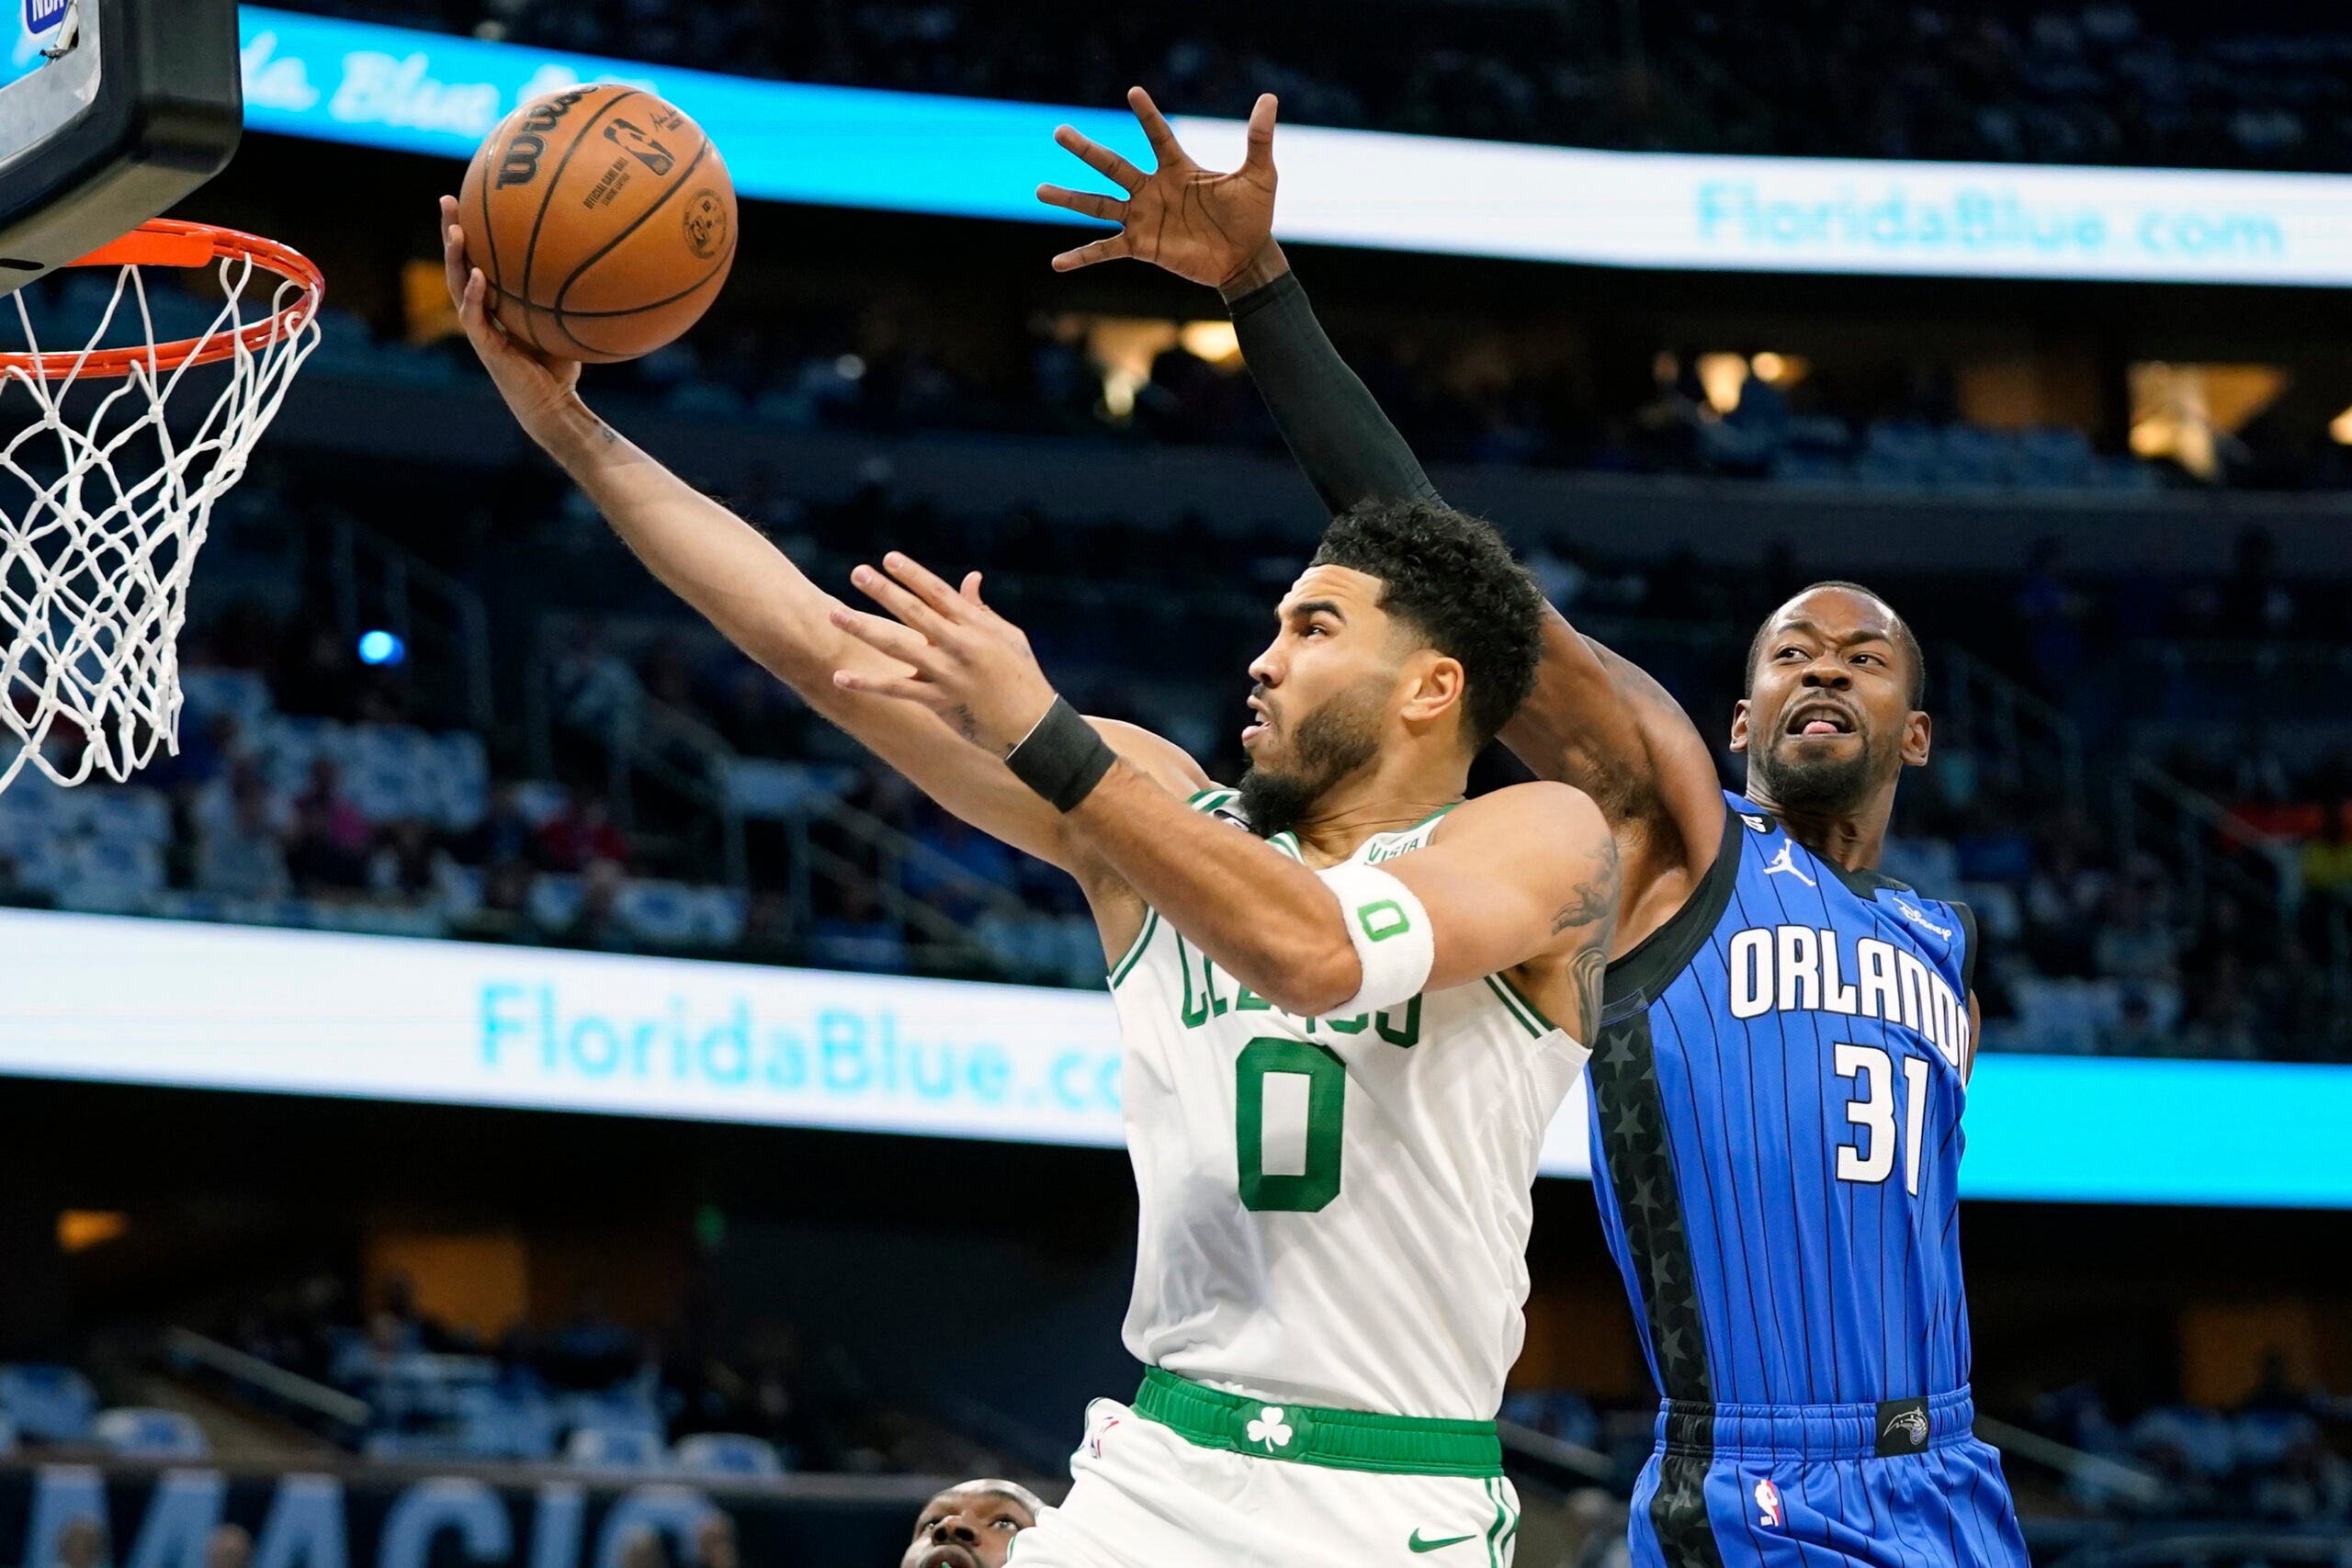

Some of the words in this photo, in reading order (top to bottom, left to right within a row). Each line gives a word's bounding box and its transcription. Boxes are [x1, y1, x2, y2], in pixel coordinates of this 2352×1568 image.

[1695, 177, 2285, 259] FloridaBlue.com
[478, 979, 1121, 1111] FloridaBlue.c
[1728, 923, 1972, 1096] ORLANDO
[1236, 1036, 1347, 1213] 0
[1834, 1041, 1929, 1197] 31
